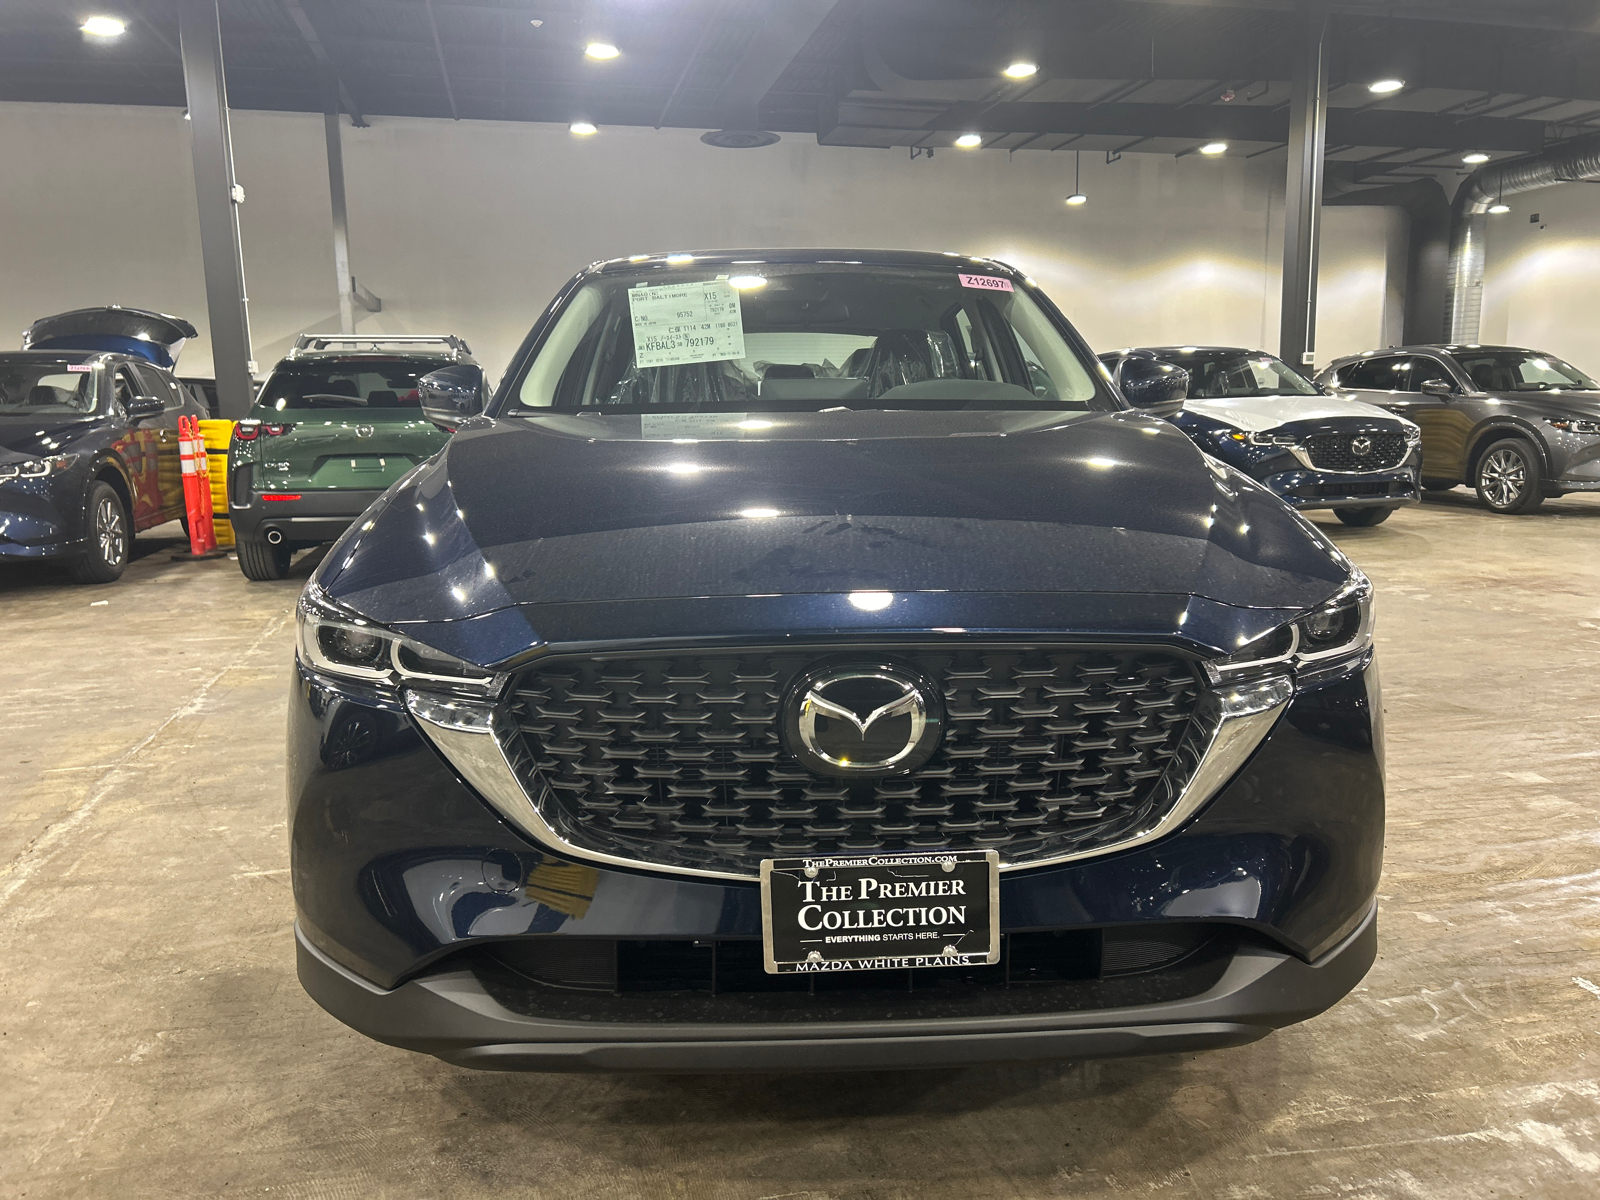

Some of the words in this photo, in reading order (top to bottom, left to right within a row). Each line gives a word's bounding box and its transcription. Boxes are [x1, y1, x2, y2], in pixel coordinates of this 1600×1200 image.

[652, 293, 687, 301] BALTIMORE
[704, 292, 717, 301] X15
[646, 340, 676, 352] KFBAL3
[685, 336, 714, 348] 792179
[858, 878, 966, 900] PREMIER
[797, 905, 966, 931] COLLECTION
[825, 934, 880, 944] EVERYTHING
[882, 932, 914, 941] STARTS
[915, 931, 940, 940] HERE.
[795, 960, 853, 972] MAZDA
[857, 958, 909, 969] WHITE
[915, 955, 971, 967] PLAINS
